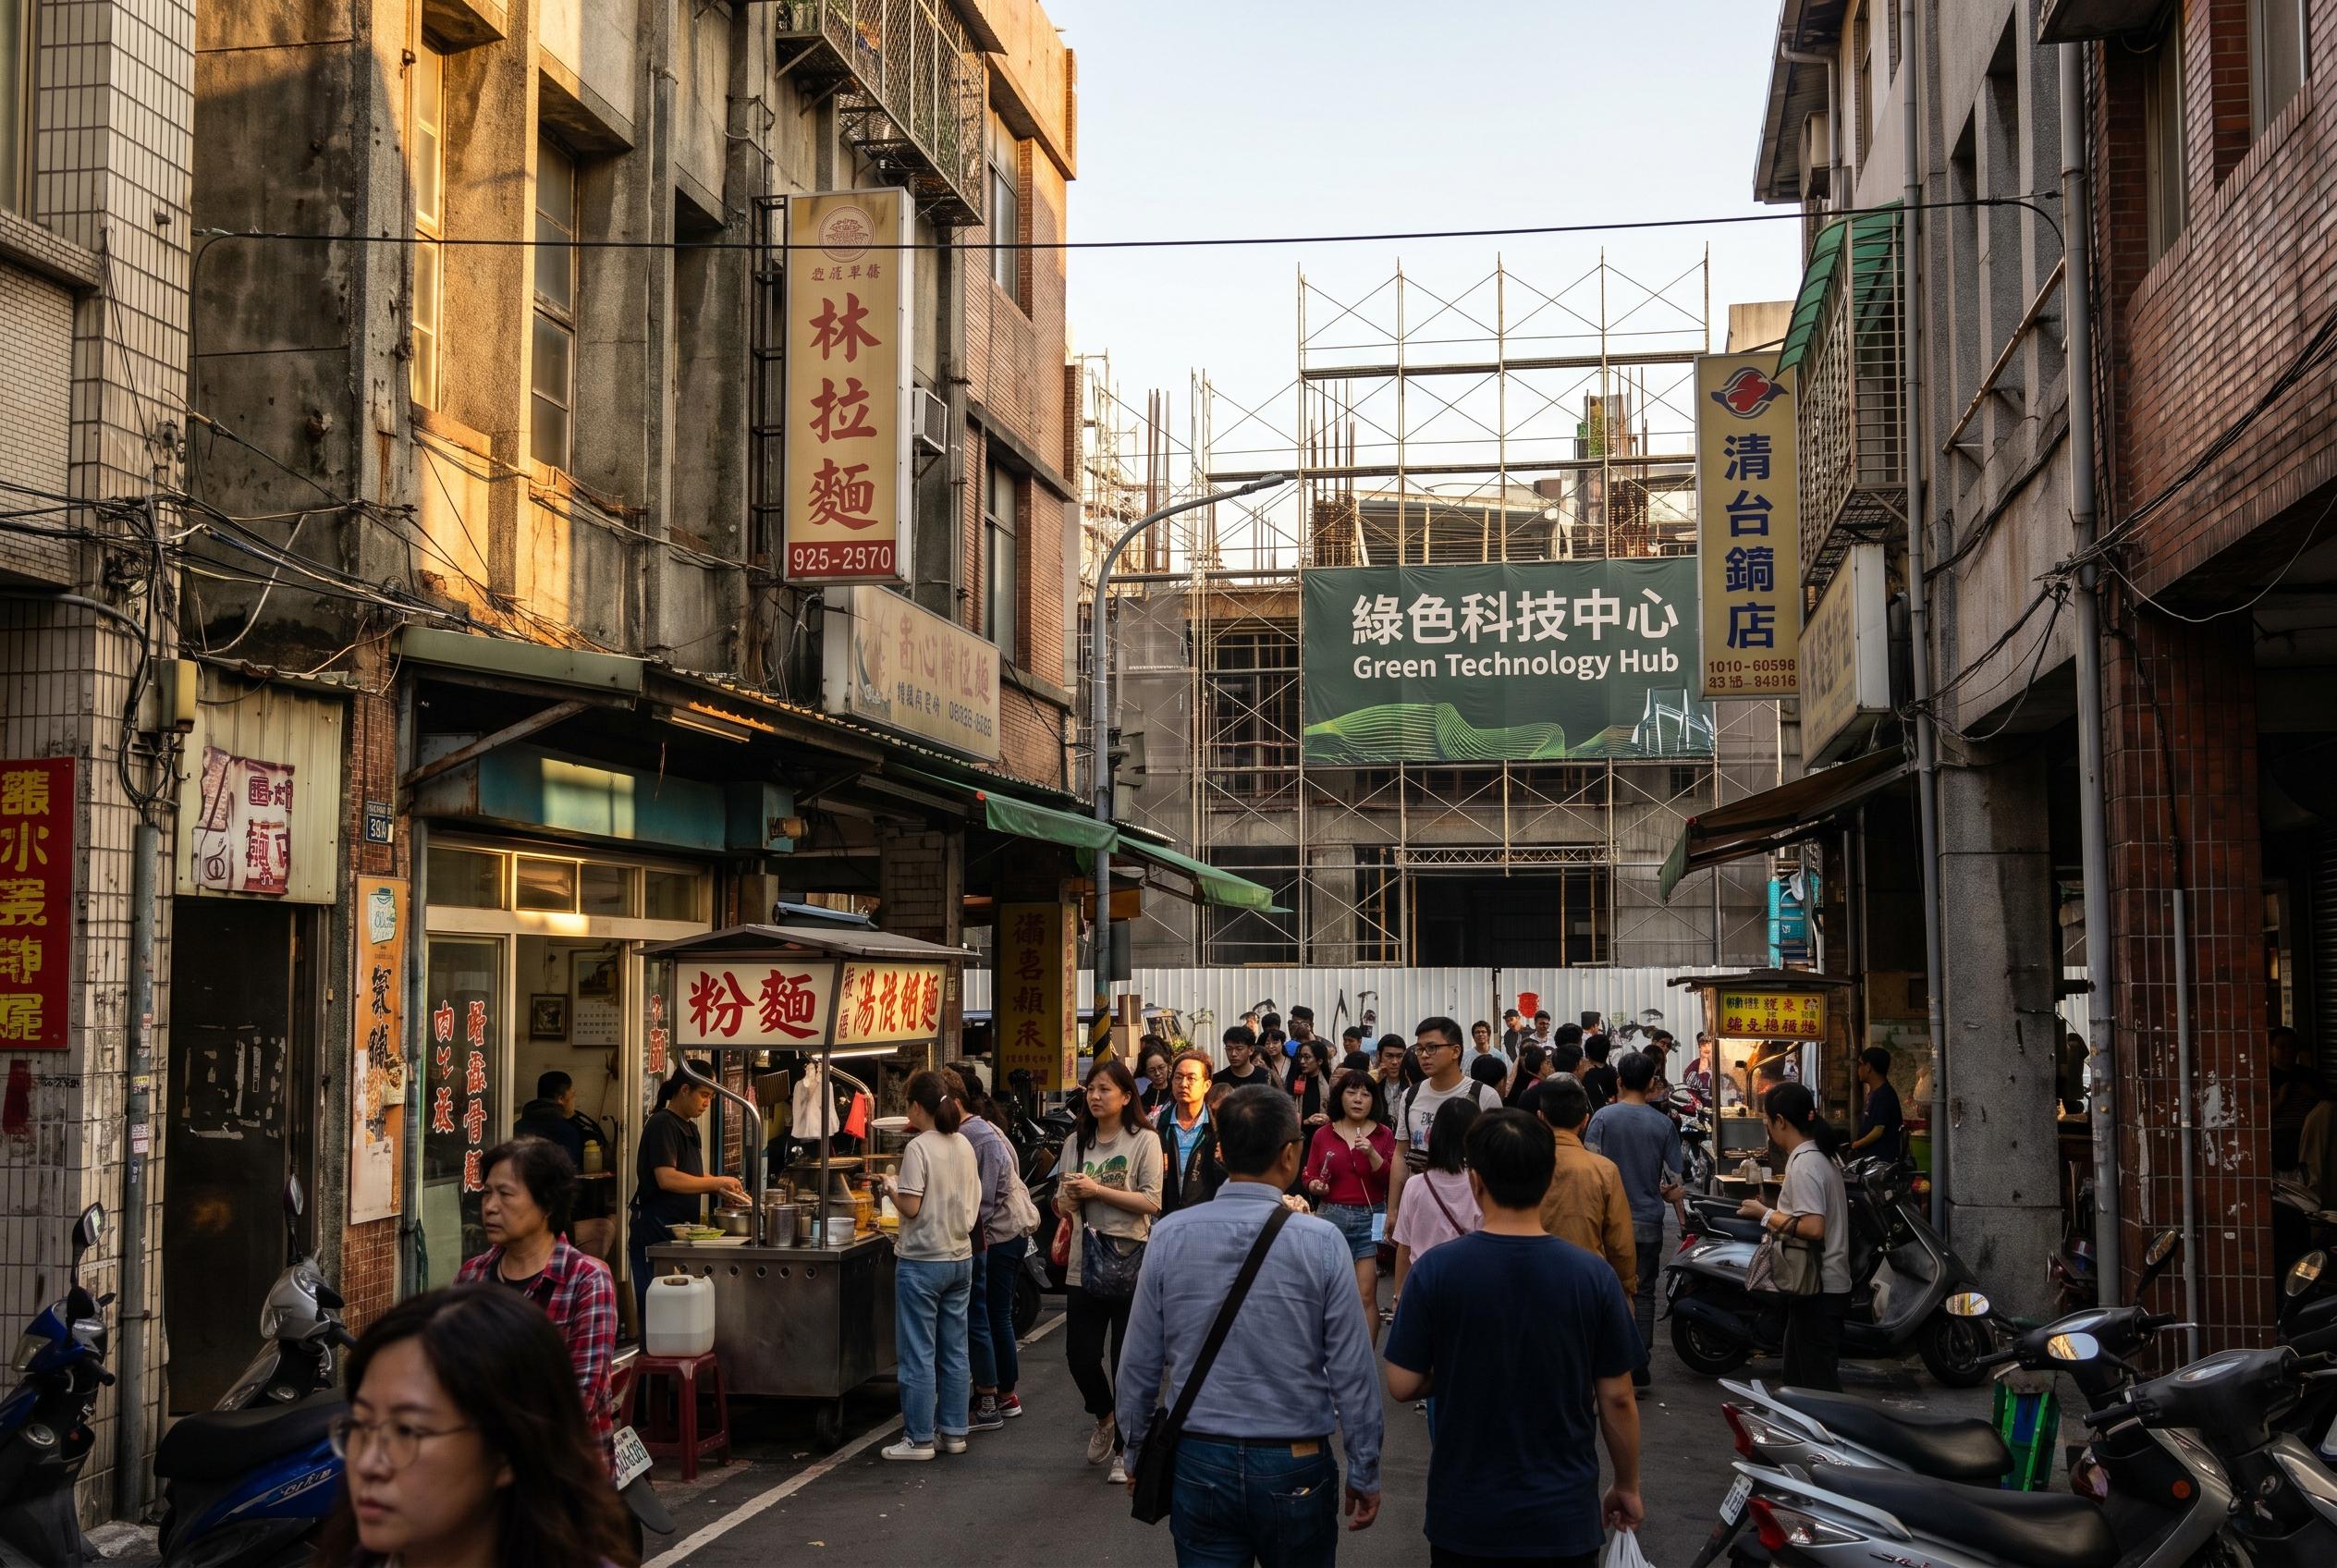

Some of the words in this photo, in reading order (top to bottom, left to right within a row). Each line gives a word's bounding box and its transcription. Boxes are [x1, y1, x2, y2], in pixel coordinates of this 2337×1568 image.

[809, 292, 882, 530] 林拉麵
[1352, 588, 1679, 645] 綠色科技中心
[1353, 655, 1437, 679] Green
[1445, 650, 1611, 680] Technology
[1621, 647, 1679, 673] Hub
[1708, 659, 1795, 673] 1010-60598
[689, 969, 820, 1039] 粉麵
